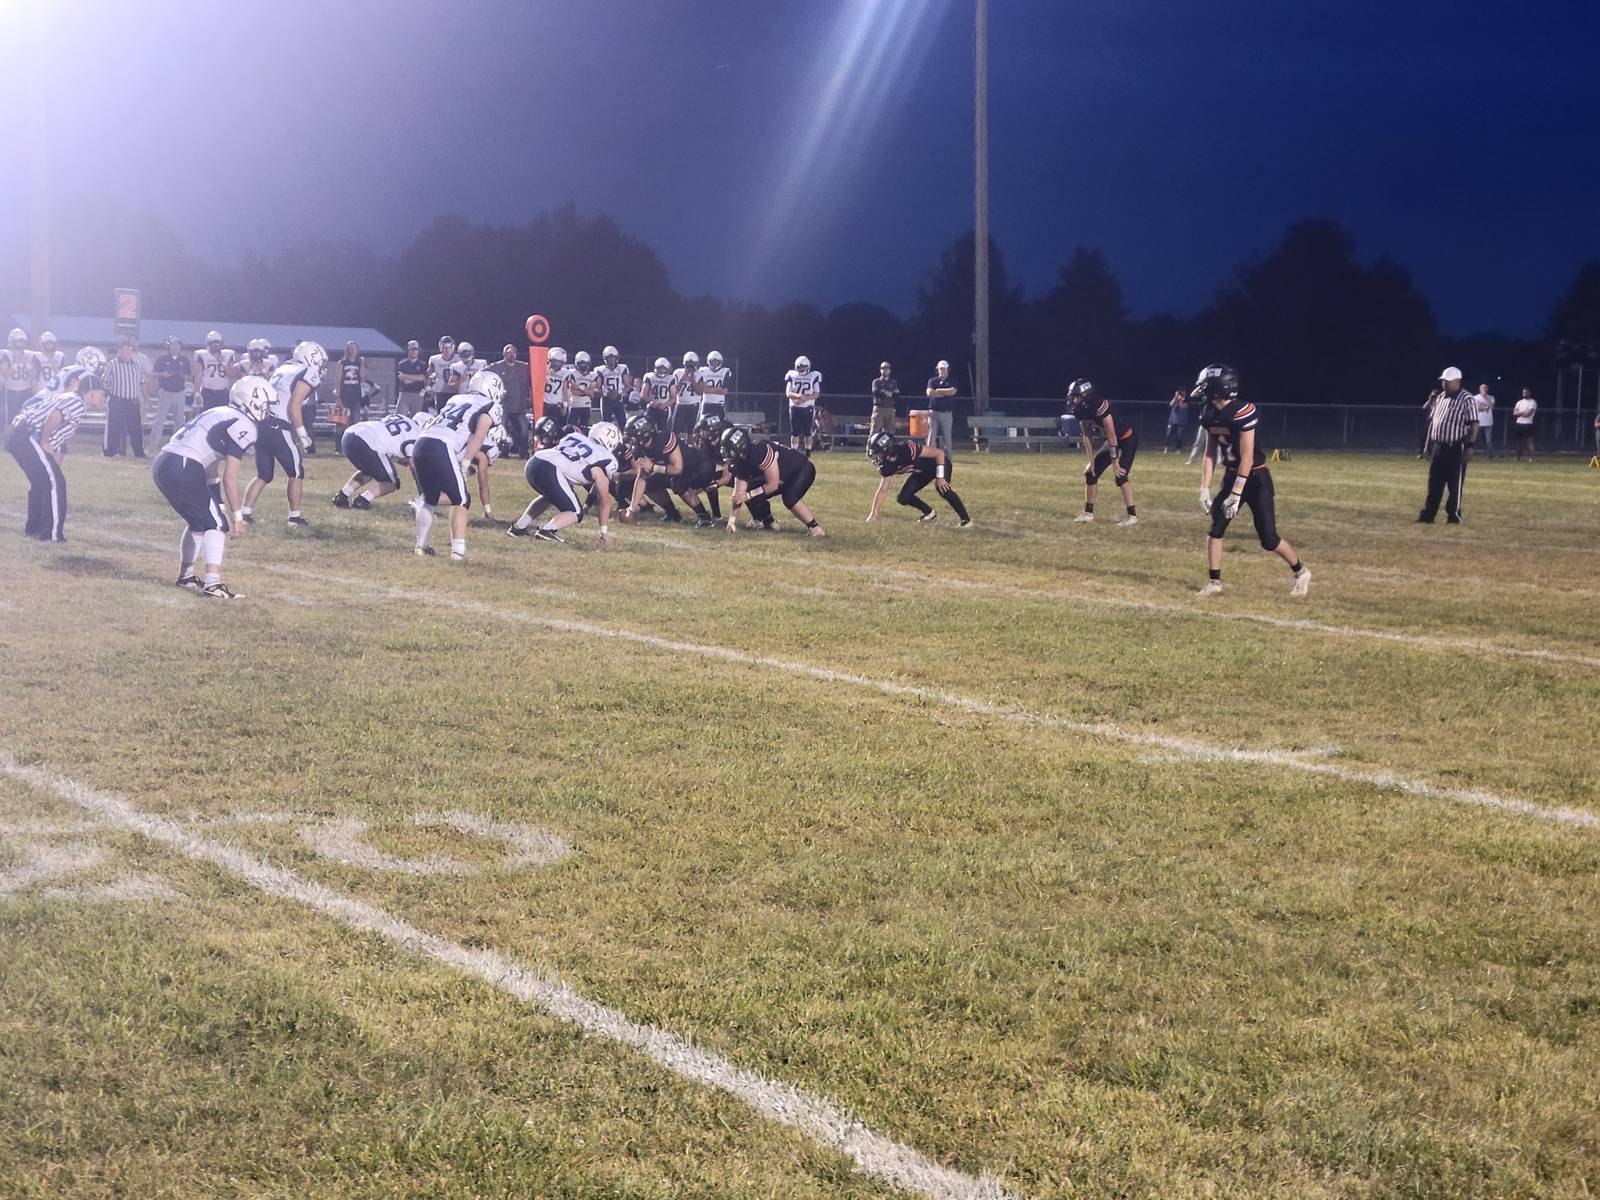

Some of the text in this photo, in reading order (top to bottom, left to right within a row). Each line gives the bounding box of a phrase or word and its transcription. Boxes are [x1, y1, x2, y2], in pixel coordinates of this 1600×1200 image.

[118, 293, 138, 319] 2
[251, 387, 260, 400] 4
[651, 384, 668, 400] 40
[680, 382, 696, 397] 74
[794, 381, 811, 395] 72
